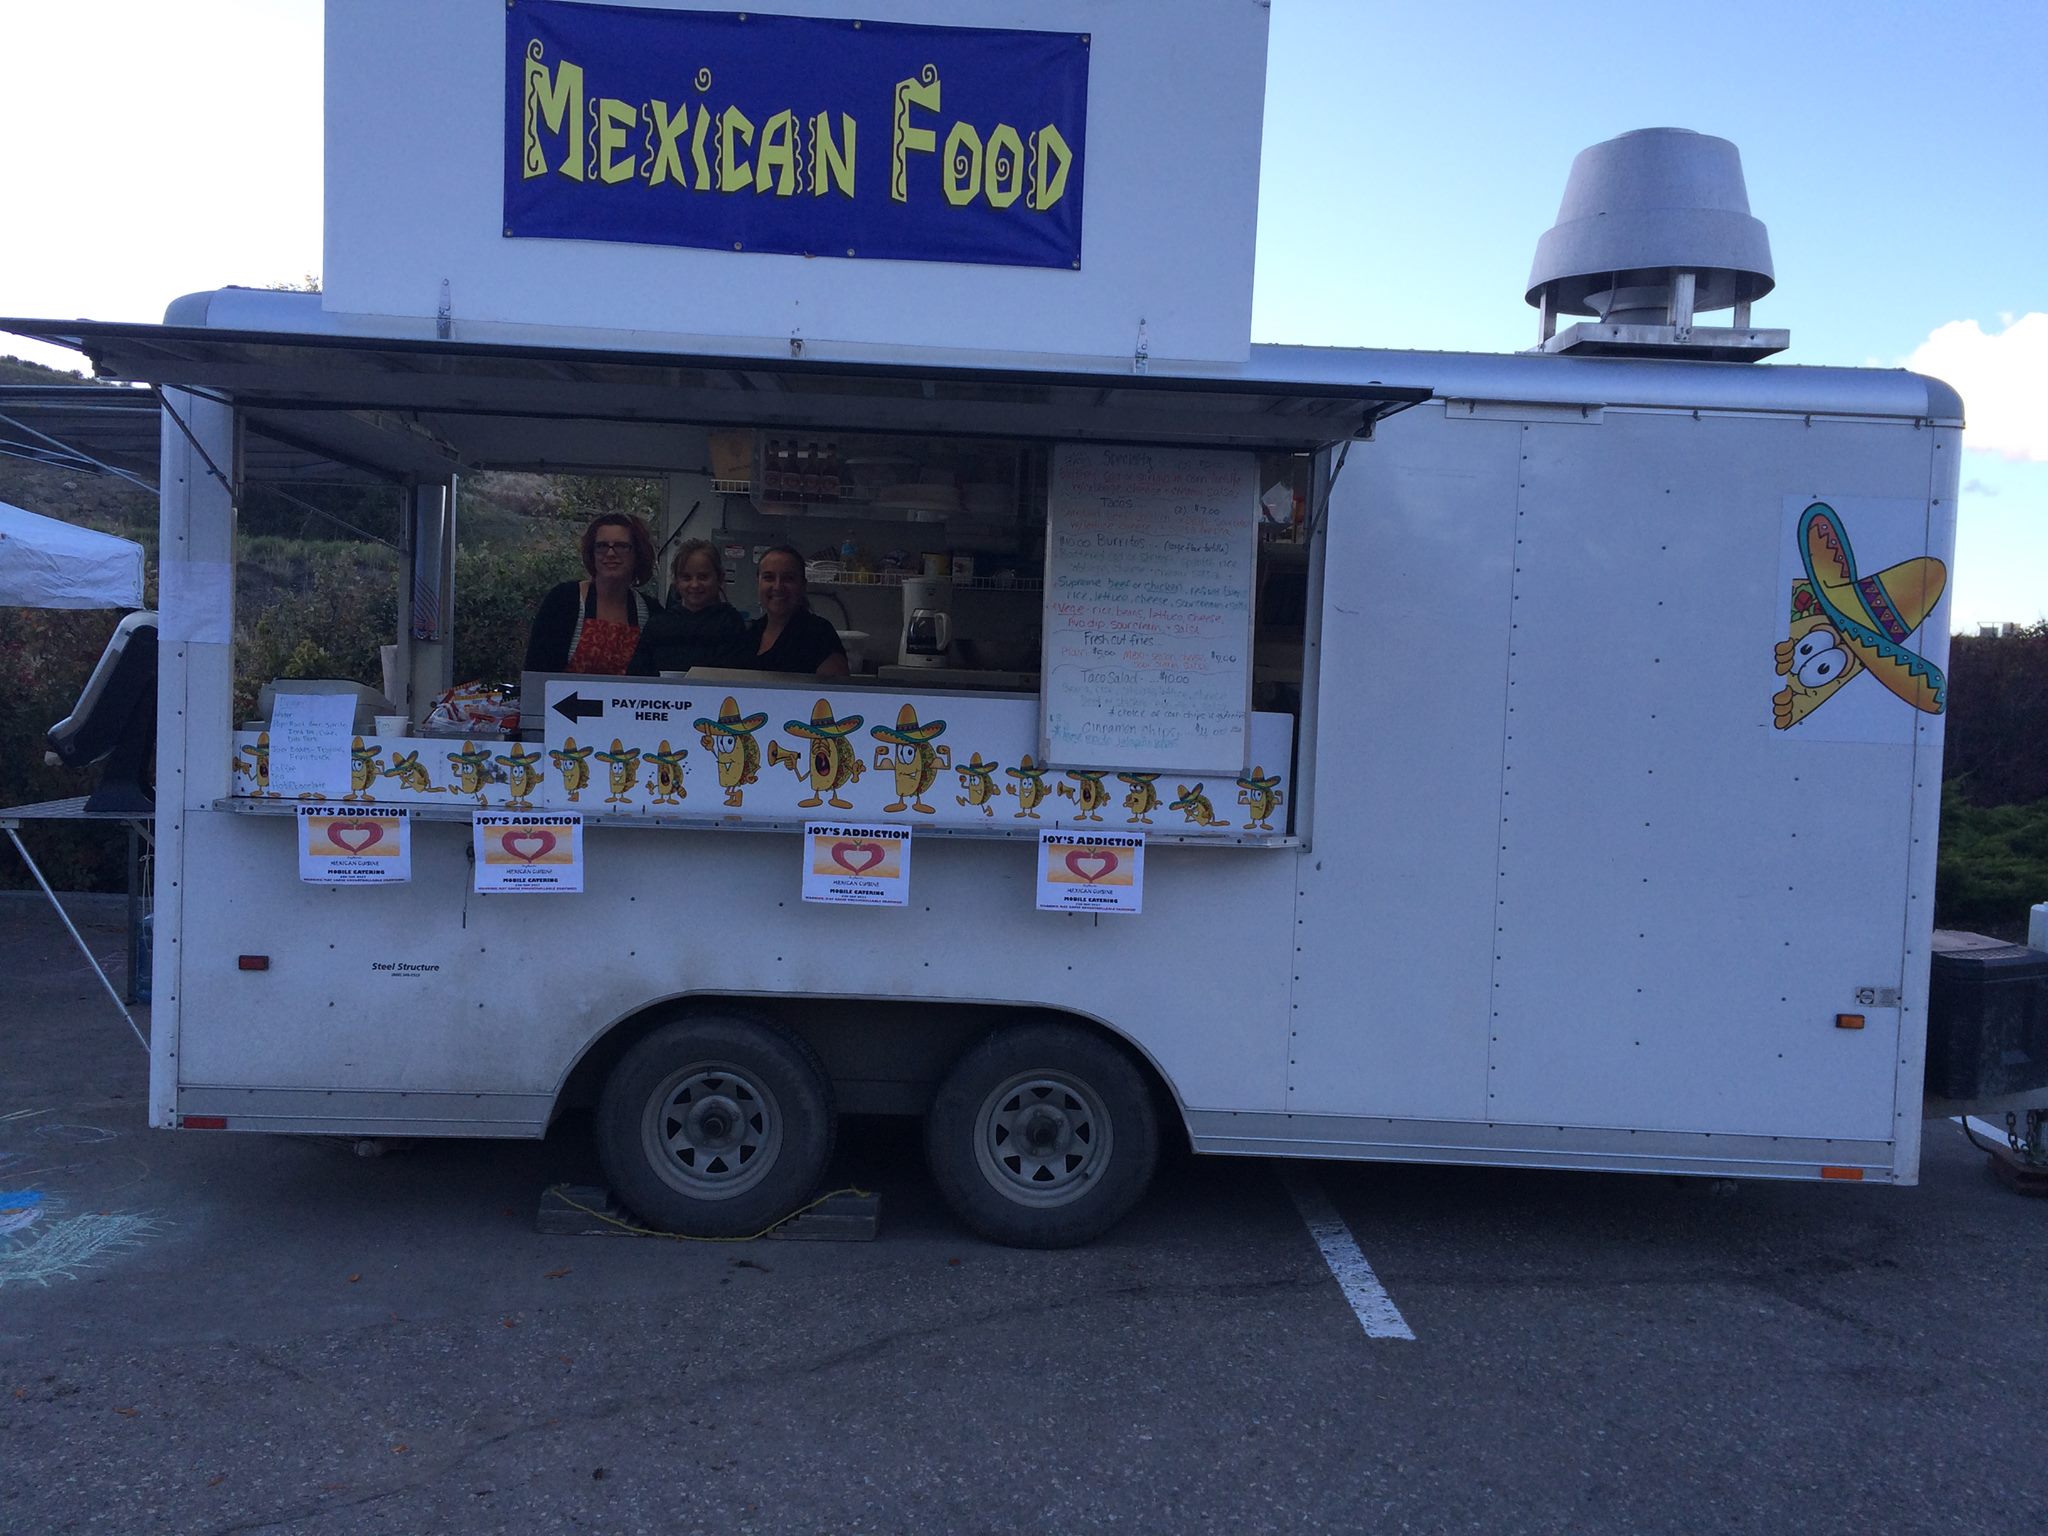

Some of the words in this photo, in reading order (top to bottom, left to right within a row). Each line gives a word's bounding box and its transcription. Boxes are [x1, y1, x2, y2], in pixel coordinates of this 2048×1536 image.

[891, 63, 1073, 210] FOOD
[1099, 496, 1134, 509] Tacos
[1097, 533, 1145, 549] Burritos
[611, 699, 692, 710] PAY/PICK-UP
[635, 711, 669, 721] HERE
[300, 806, 335, 816] JOY'S
[337, 807, 407, 817] ADDICTION
[475, 816, 510, 825] JOY'S
[511, 816, 581, 825] ADDICTION
[808, 826, 841, 836] JOY'S
[842, 828, 909, 839] ADDICTION
[1042, 835, 1074, 845] JOY'S
[1076, 836, 1143, 847] ADDICTION
[371, 962, 396, 971] Steel
[397, 962, 440, 972] Structure
